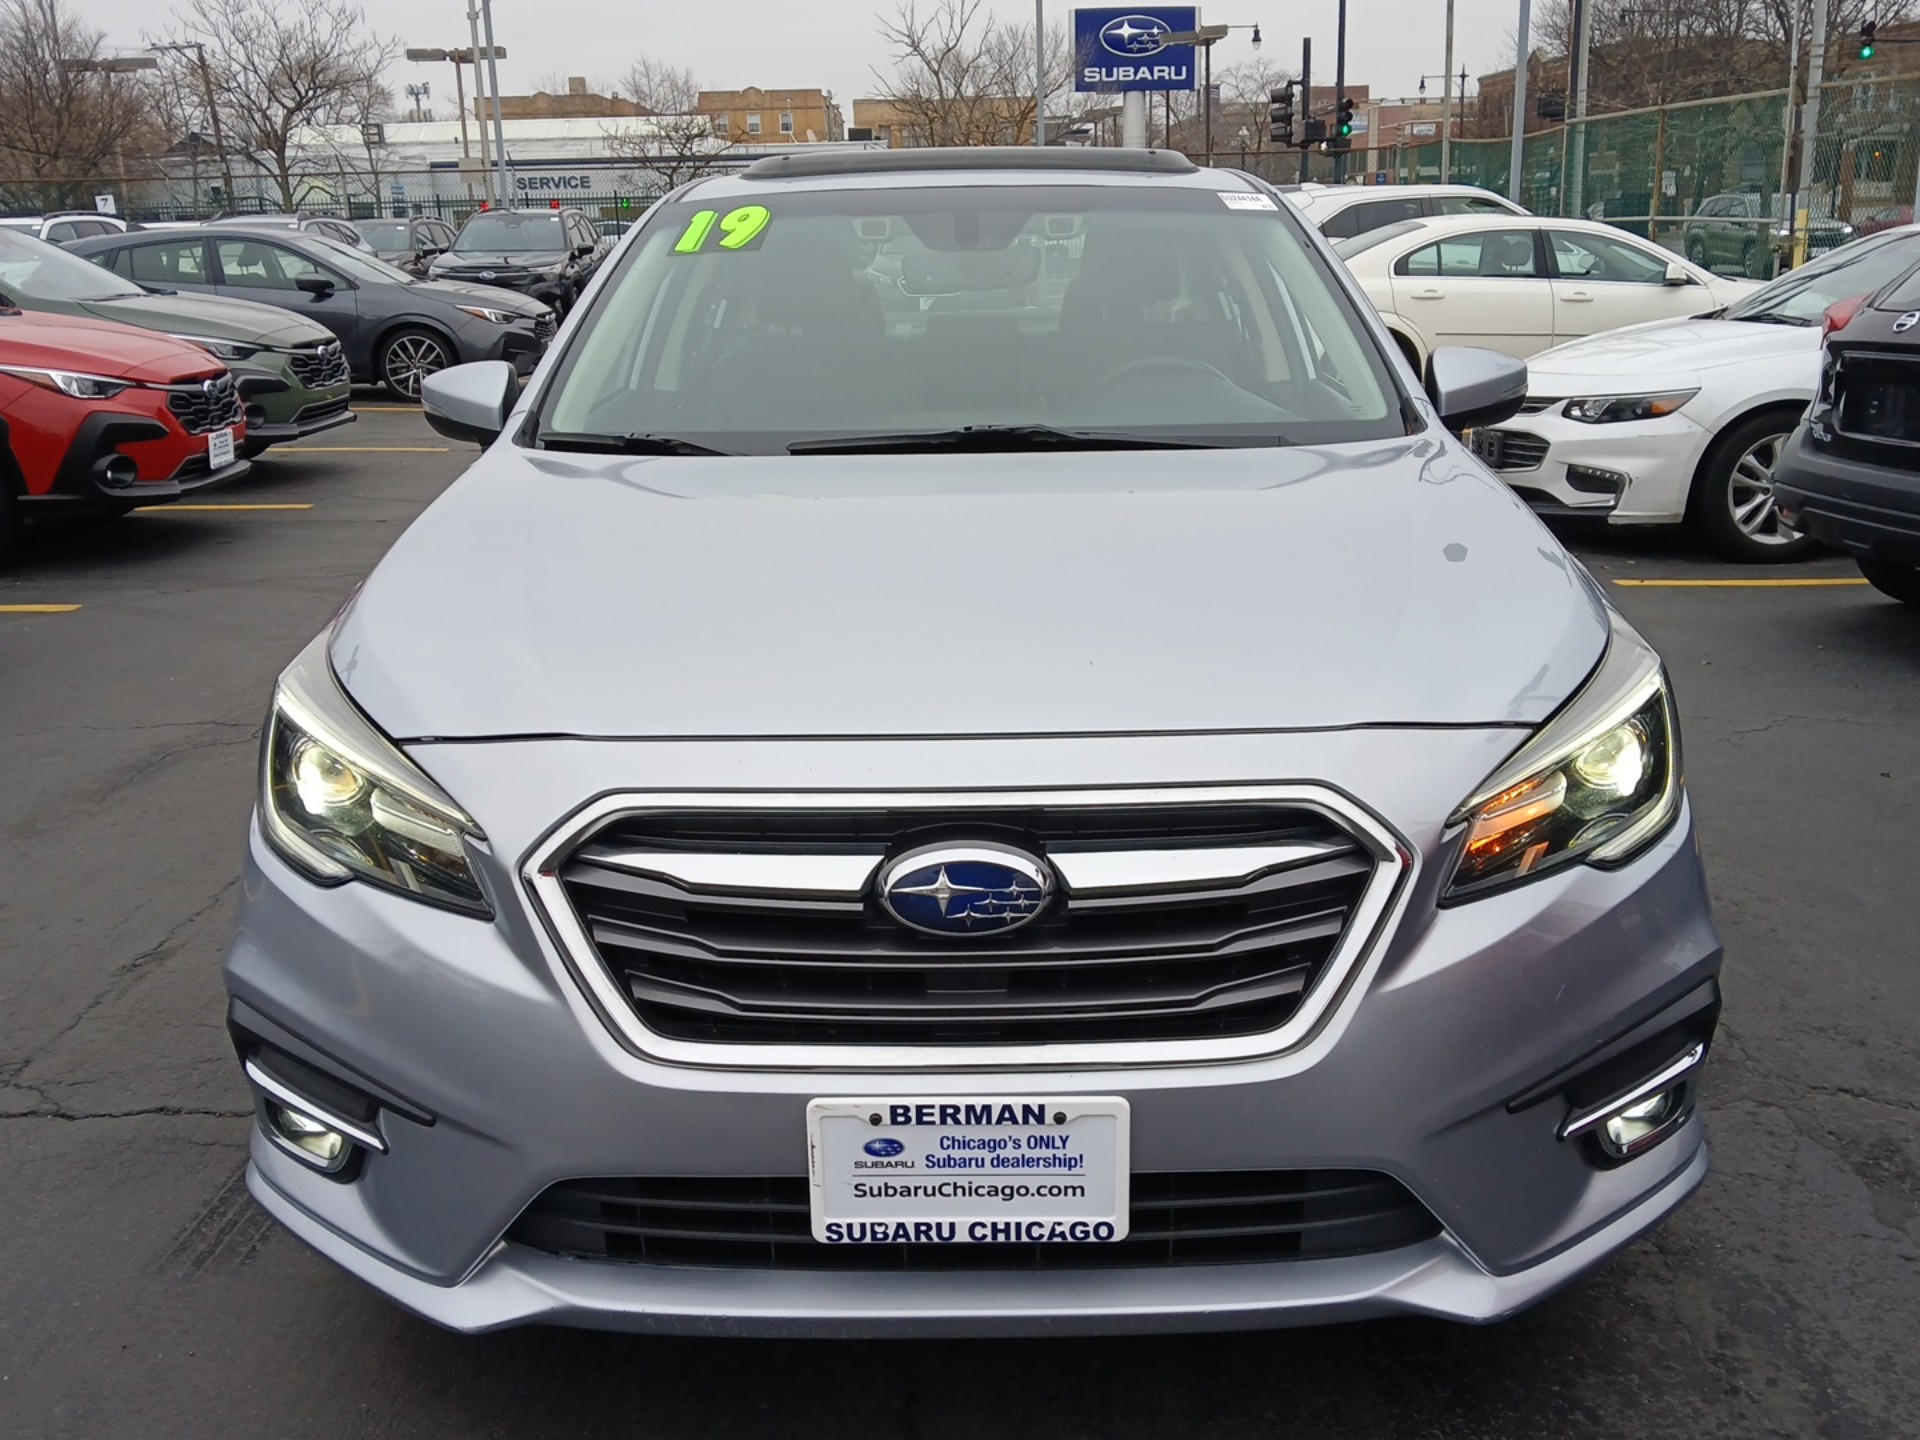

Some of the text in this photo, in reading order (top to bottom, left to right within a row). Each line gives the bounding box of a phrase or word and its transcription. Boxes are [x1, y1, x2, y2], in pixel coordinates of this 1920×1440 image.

[1083, 66, 1187, 82] SUBARU
[516, 175, 591, 190] SERVICE
[100, 197, 109, 208] 7
[674, 204, 771, 254] 19
[889, 1103, 1046, 1126] BERMAN
[939, 1134, 1070, 1153] Chicago's ONLY
[854, 1160, 916, 1169] SUBARU
[925, 1153, 1084, 1171] Subaru dealership!
[854, 1181, 1086, 1202] SubaruChicago.com
[825, 1220, 1116, 1243] SUBARU CHICAGO
